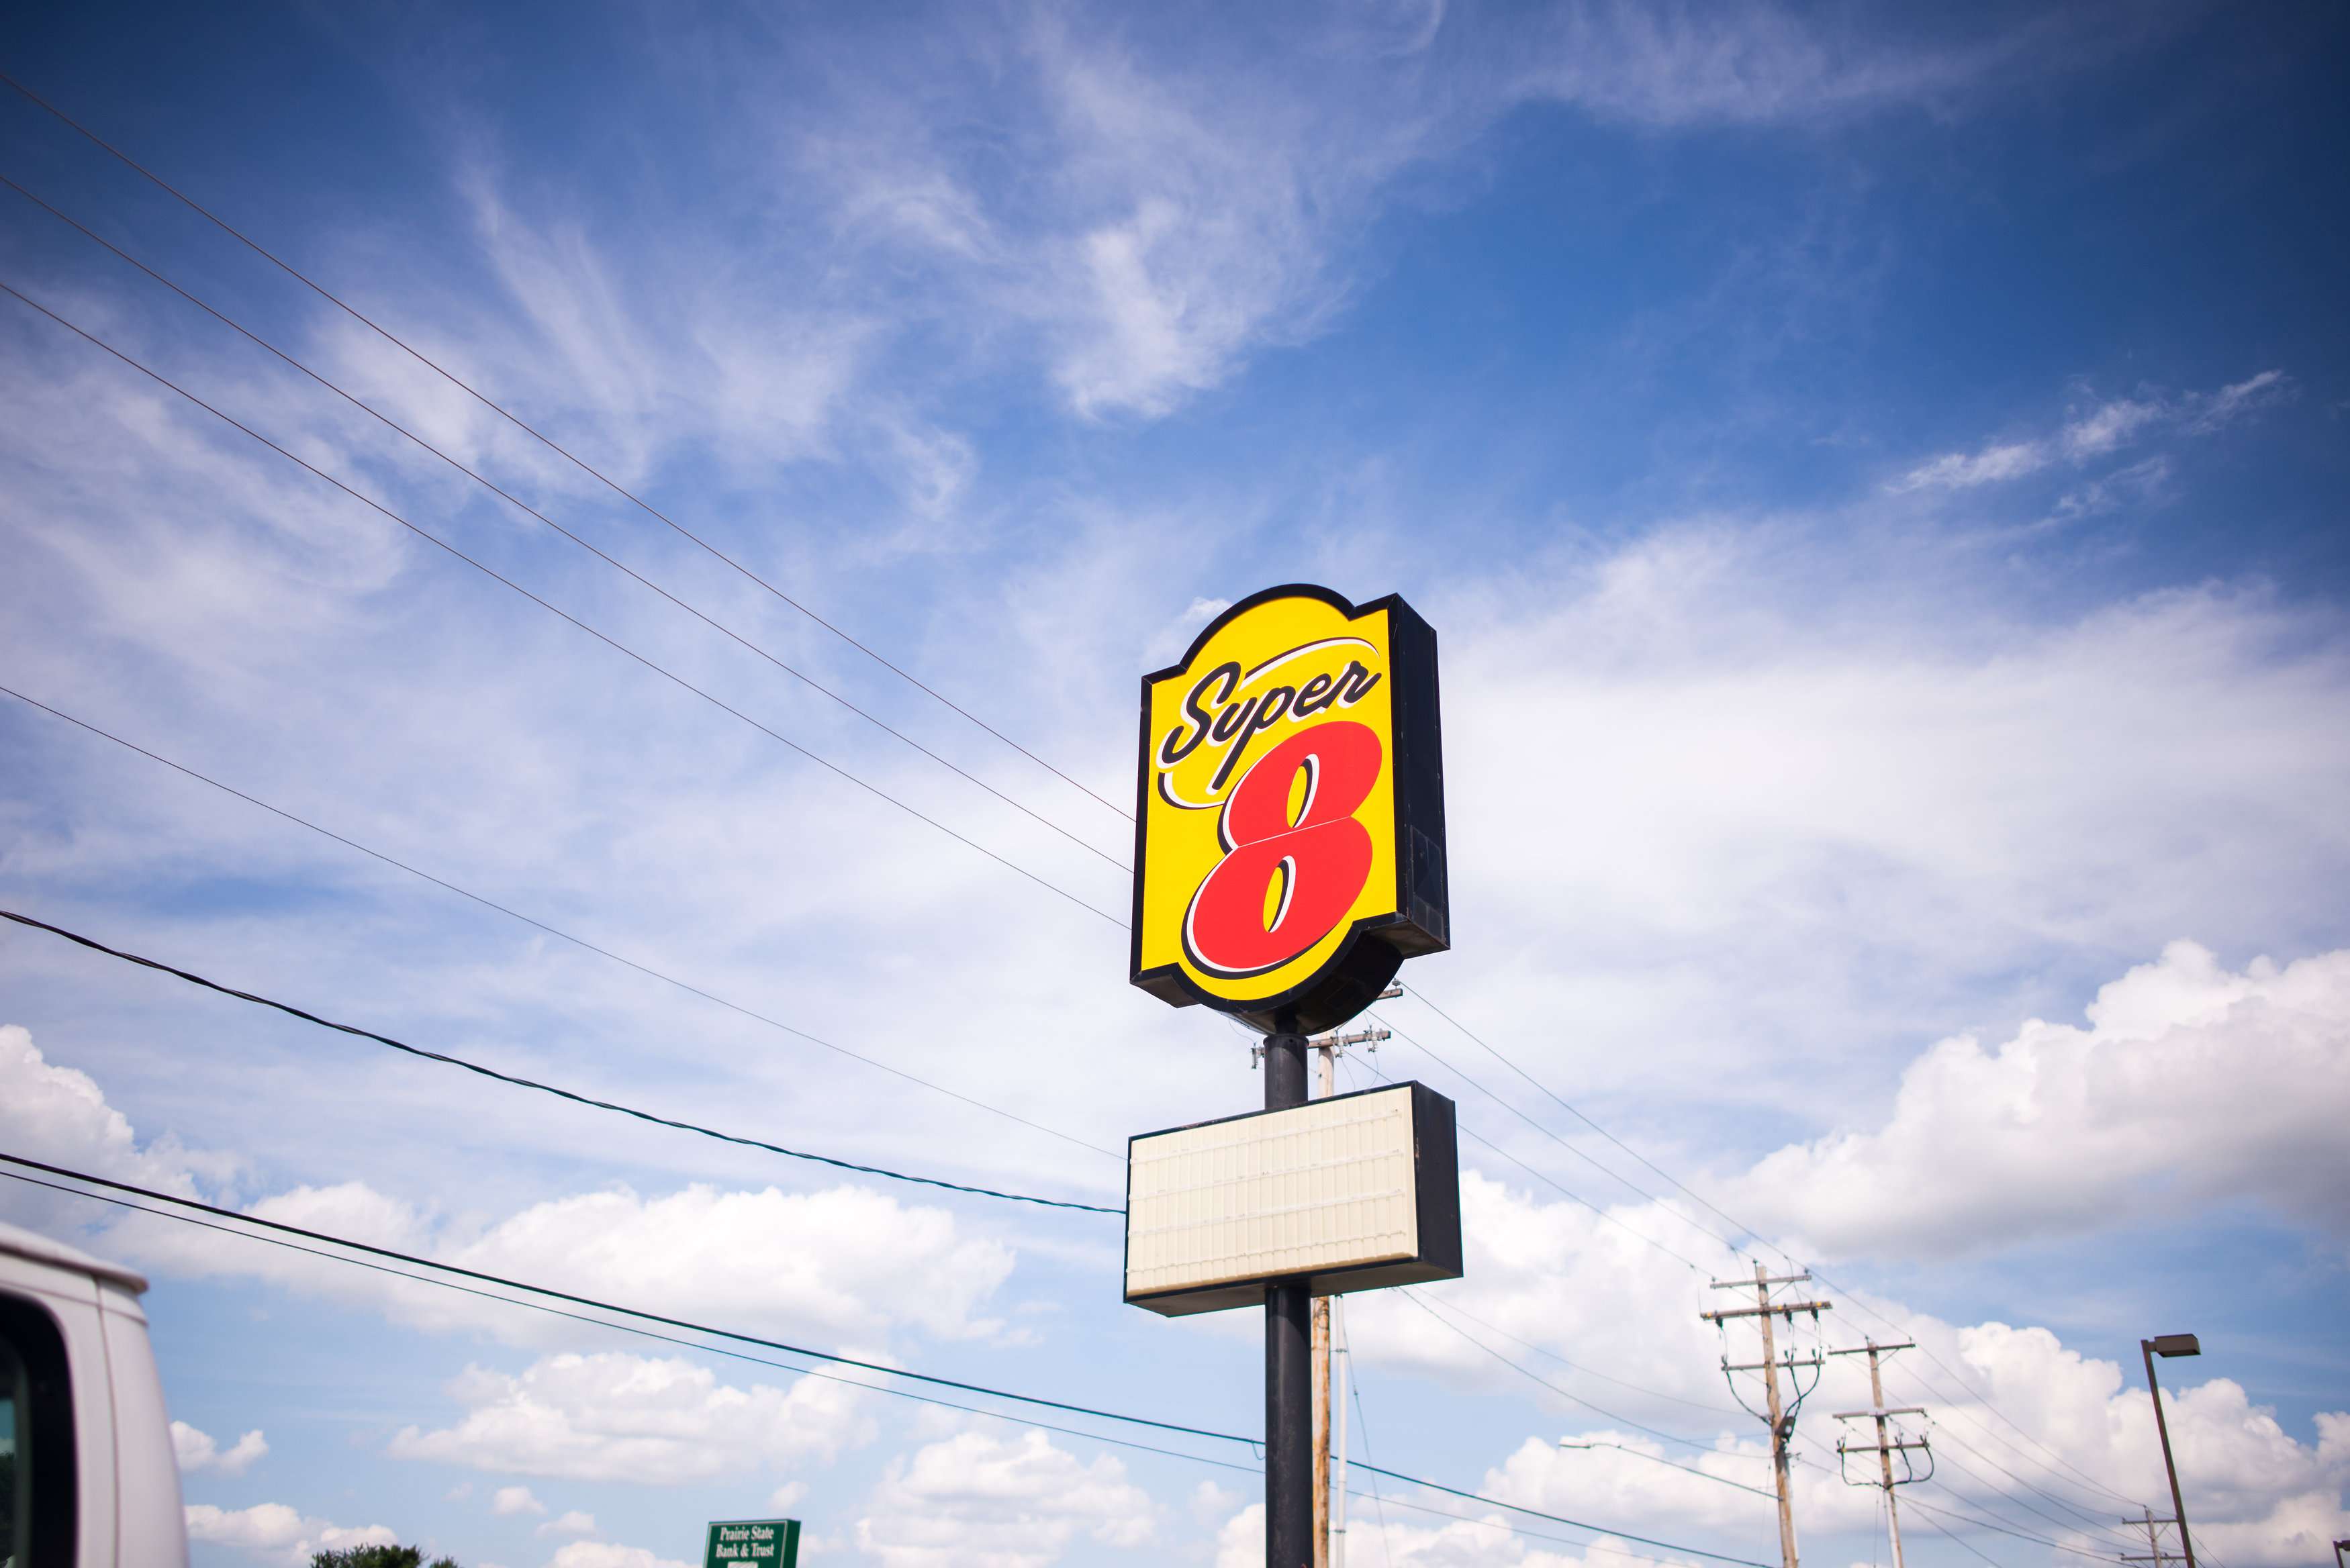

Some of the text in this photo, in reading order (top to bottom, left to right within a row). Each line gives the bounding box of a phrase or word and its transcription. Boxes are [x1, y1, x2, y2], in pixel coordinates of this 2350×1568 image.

[1157, 660, 1382, 795] Super
[1182, 721, 1382, 980] 8
[716, 1543, 774, 1558] Bank & Trust
[720, 1525, 774, 1541] Prairie State
